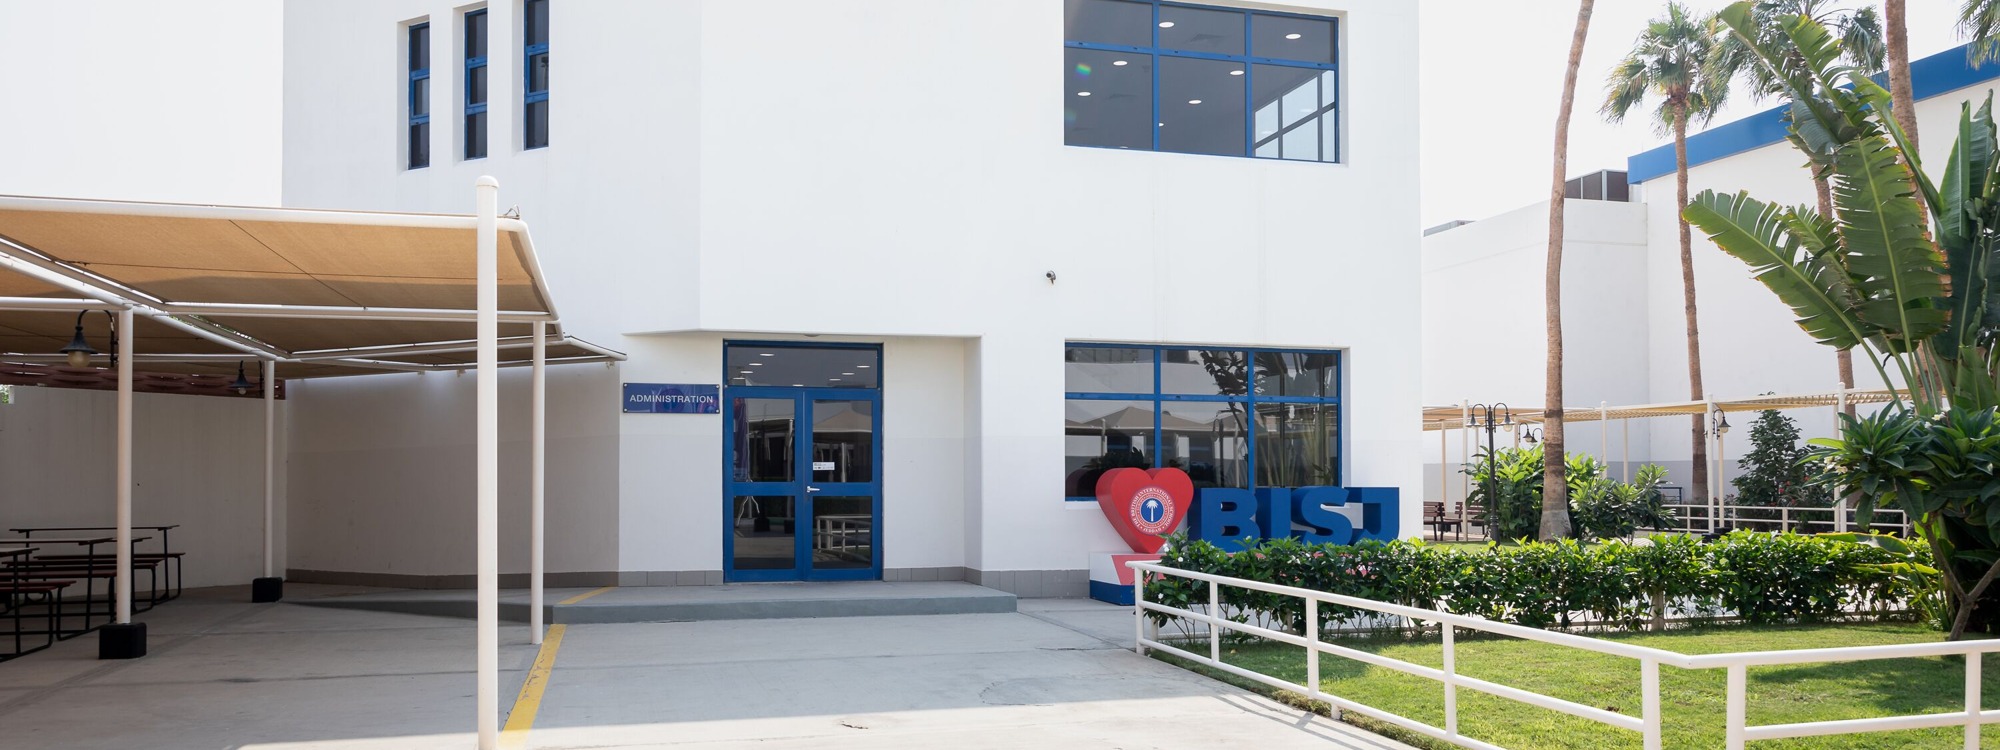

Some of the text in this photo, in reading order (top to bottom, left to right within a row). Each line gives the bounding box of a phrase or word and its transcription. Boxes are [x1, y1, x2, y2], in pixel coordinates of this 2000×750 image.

[629, 394, 714, 403] ADMINISTRATION
[1138, 487, 1172, 505] INTERNATIONAL
[1200, 486, 1399, 553] BISJ
